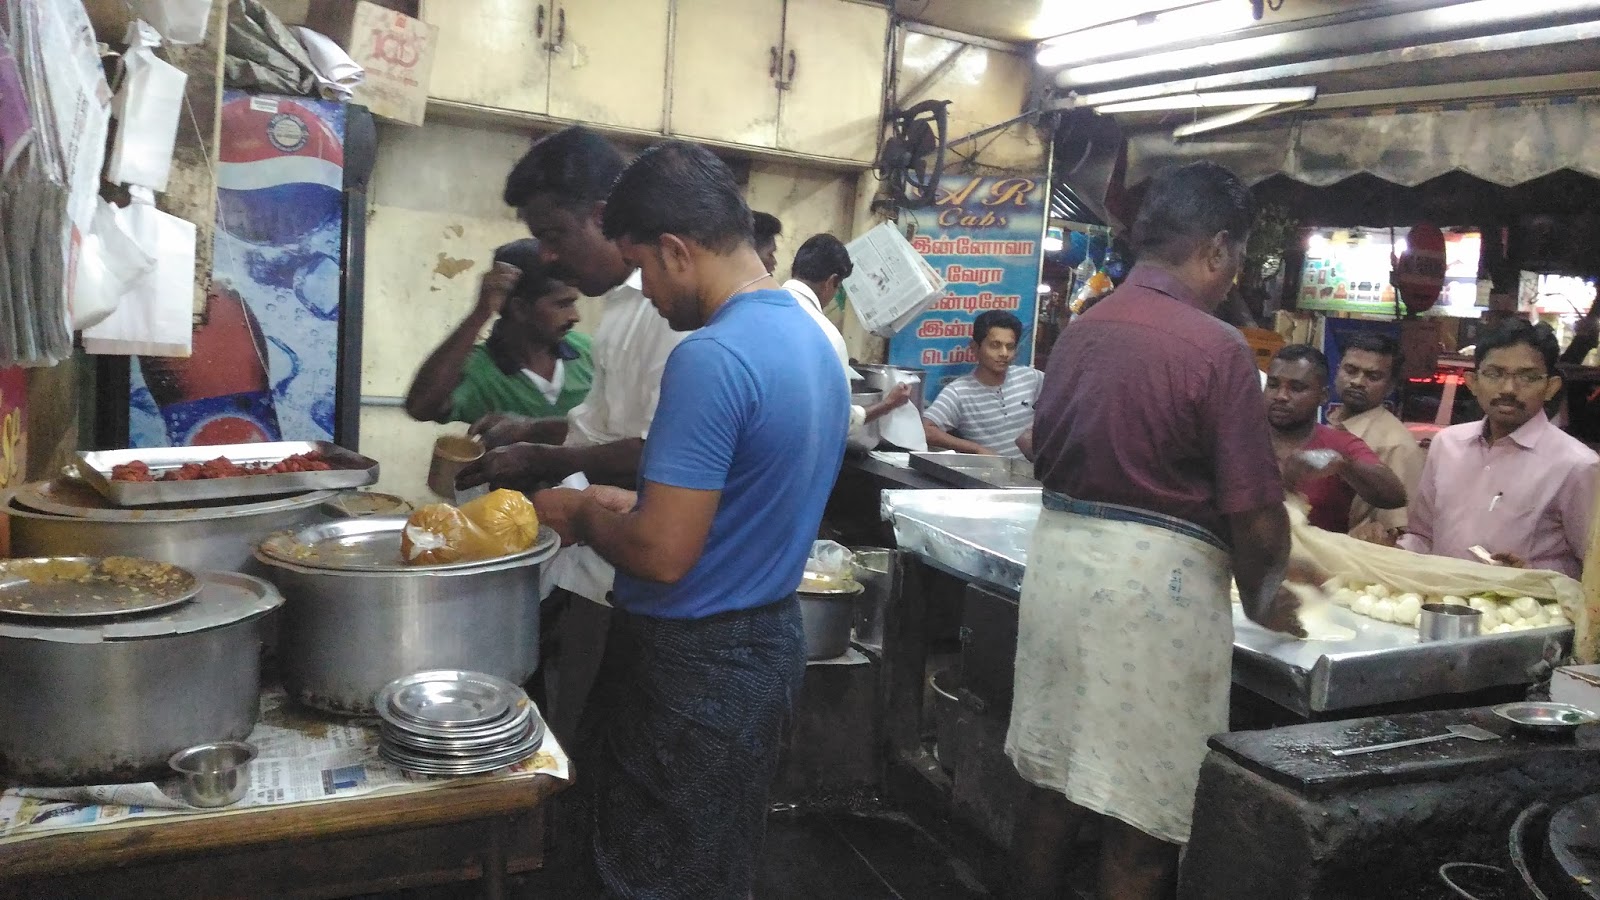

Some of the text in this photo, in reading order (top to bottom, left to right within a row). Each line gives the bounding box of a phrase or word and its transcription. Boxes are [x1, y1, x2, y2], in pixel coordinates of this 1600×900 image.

[938, 207, 1007, 226] Cabs
[935, 265, 1003, 285] வேரா
[928, 292, 1020, 313] ன்டிகோ
